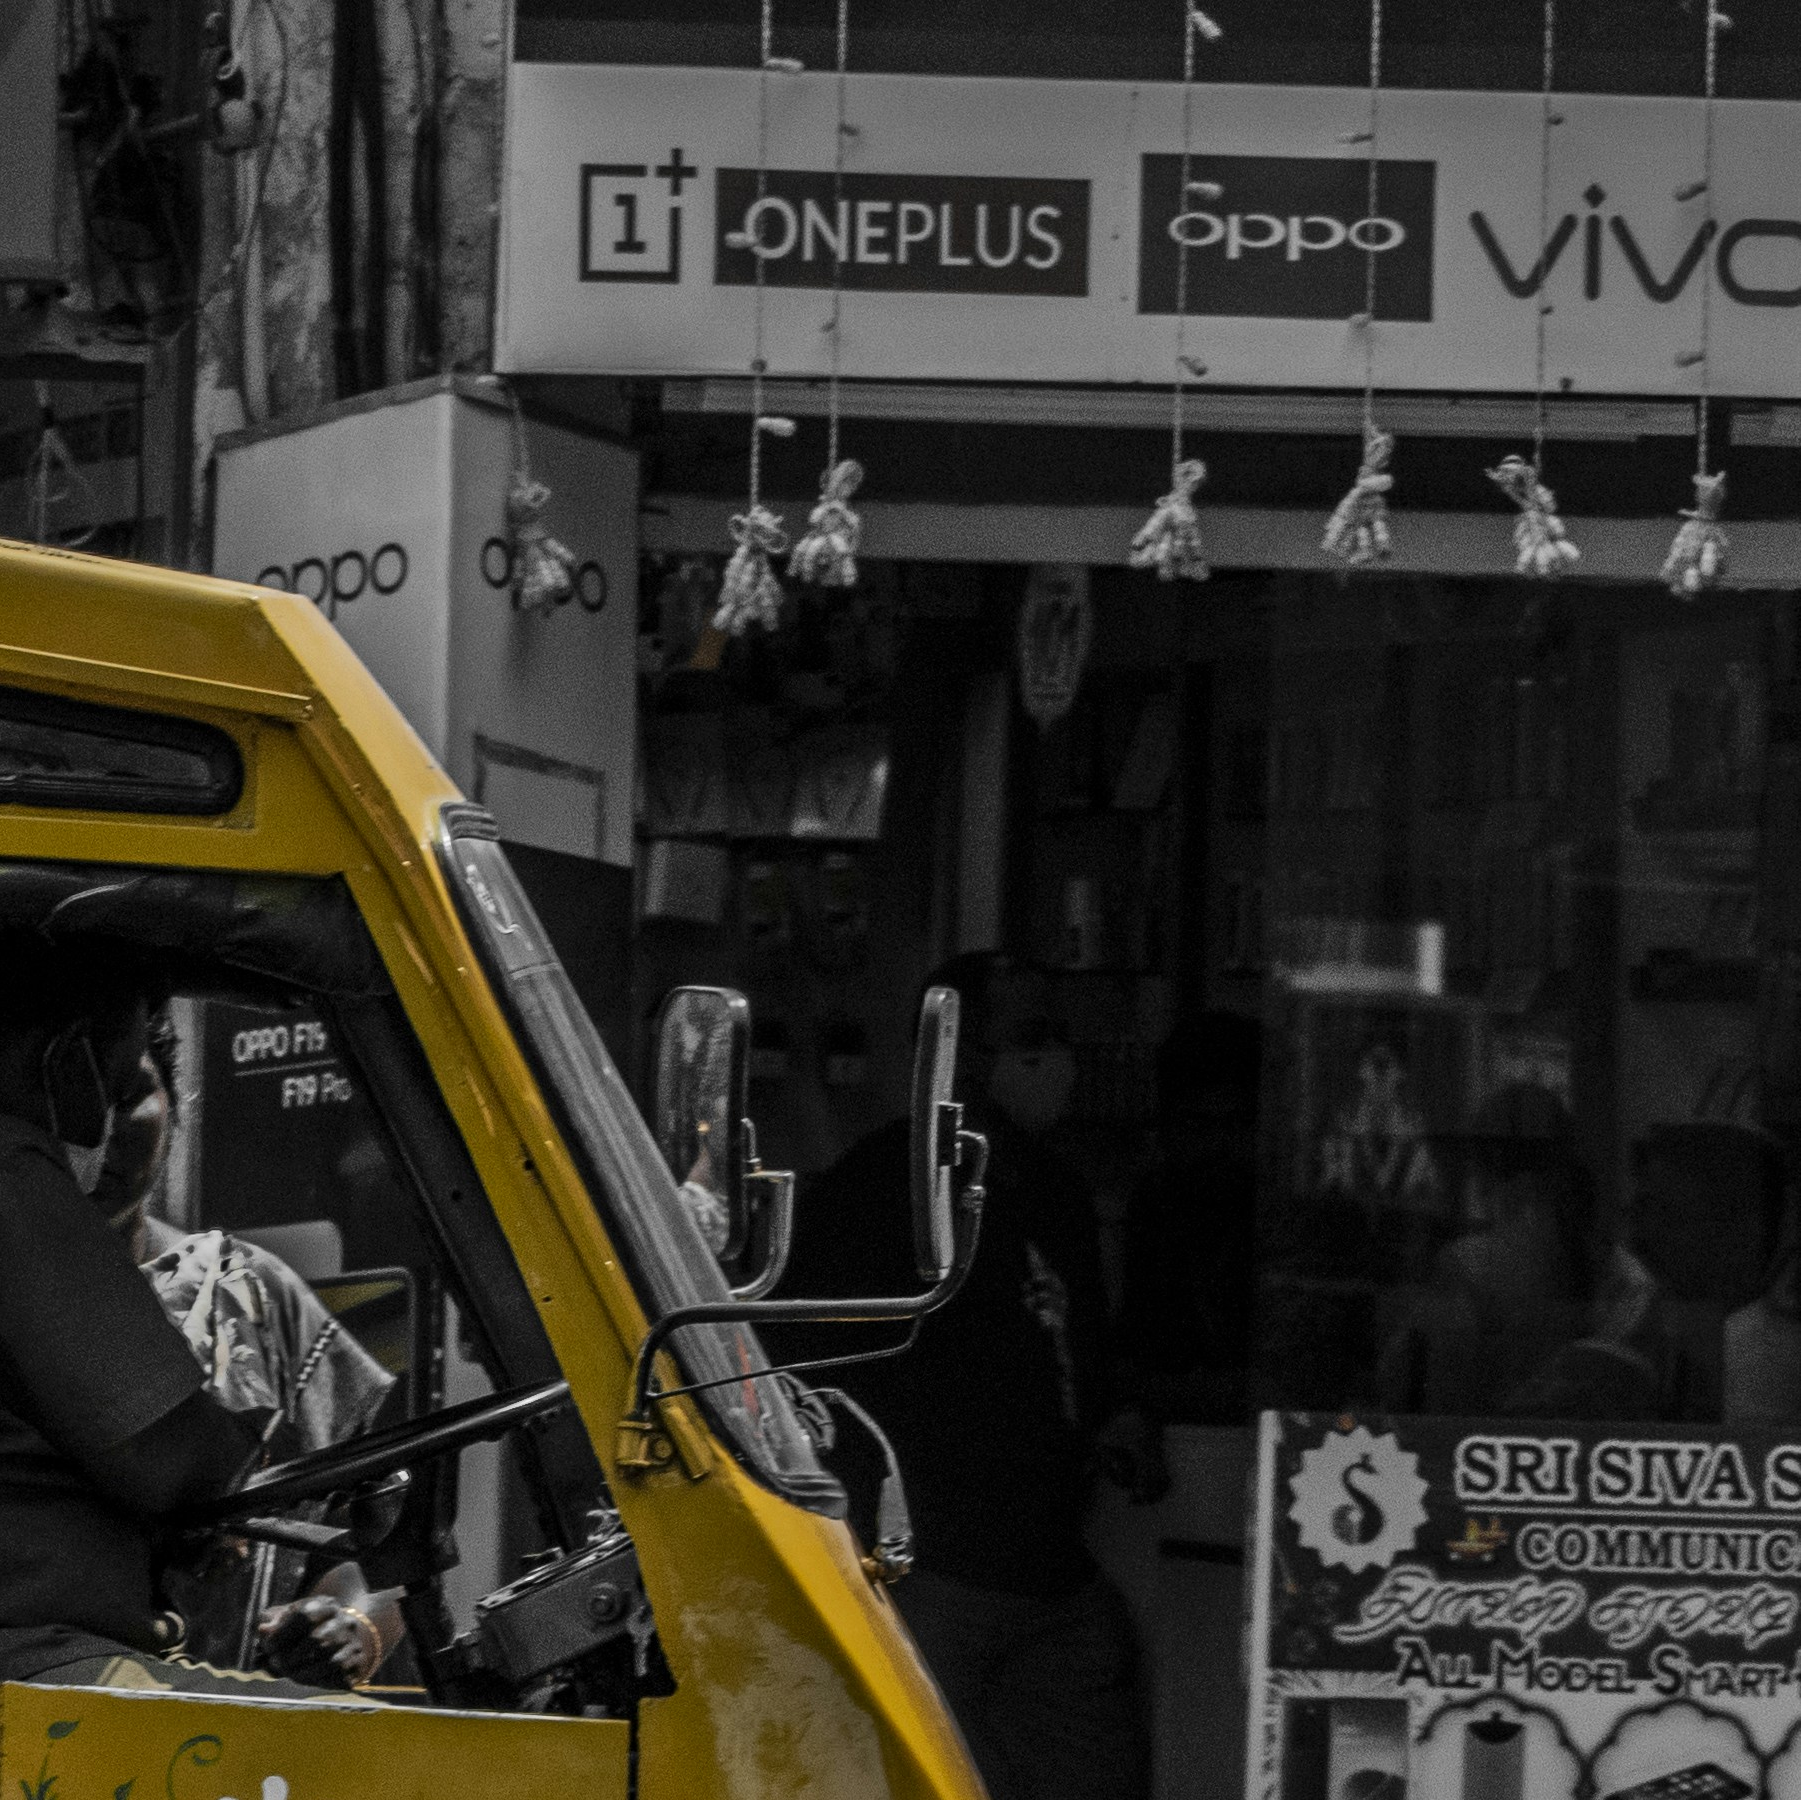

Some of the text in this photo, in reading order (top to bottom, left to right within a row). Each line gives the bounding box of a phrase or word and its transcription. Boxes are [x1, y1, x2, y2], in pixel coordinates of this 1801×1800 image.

[744, 197, 1063, 269] ONEPLUS
[1167, 211, 1406, 261] oppo
[232, 1025, 289, 1063] OPPO
[1457, 1437, 1577, 1500] SRI
[1592, 1443, 1752, 1505] SIVA
[1518, 1525, 1801, 1573] COMMUNIC
